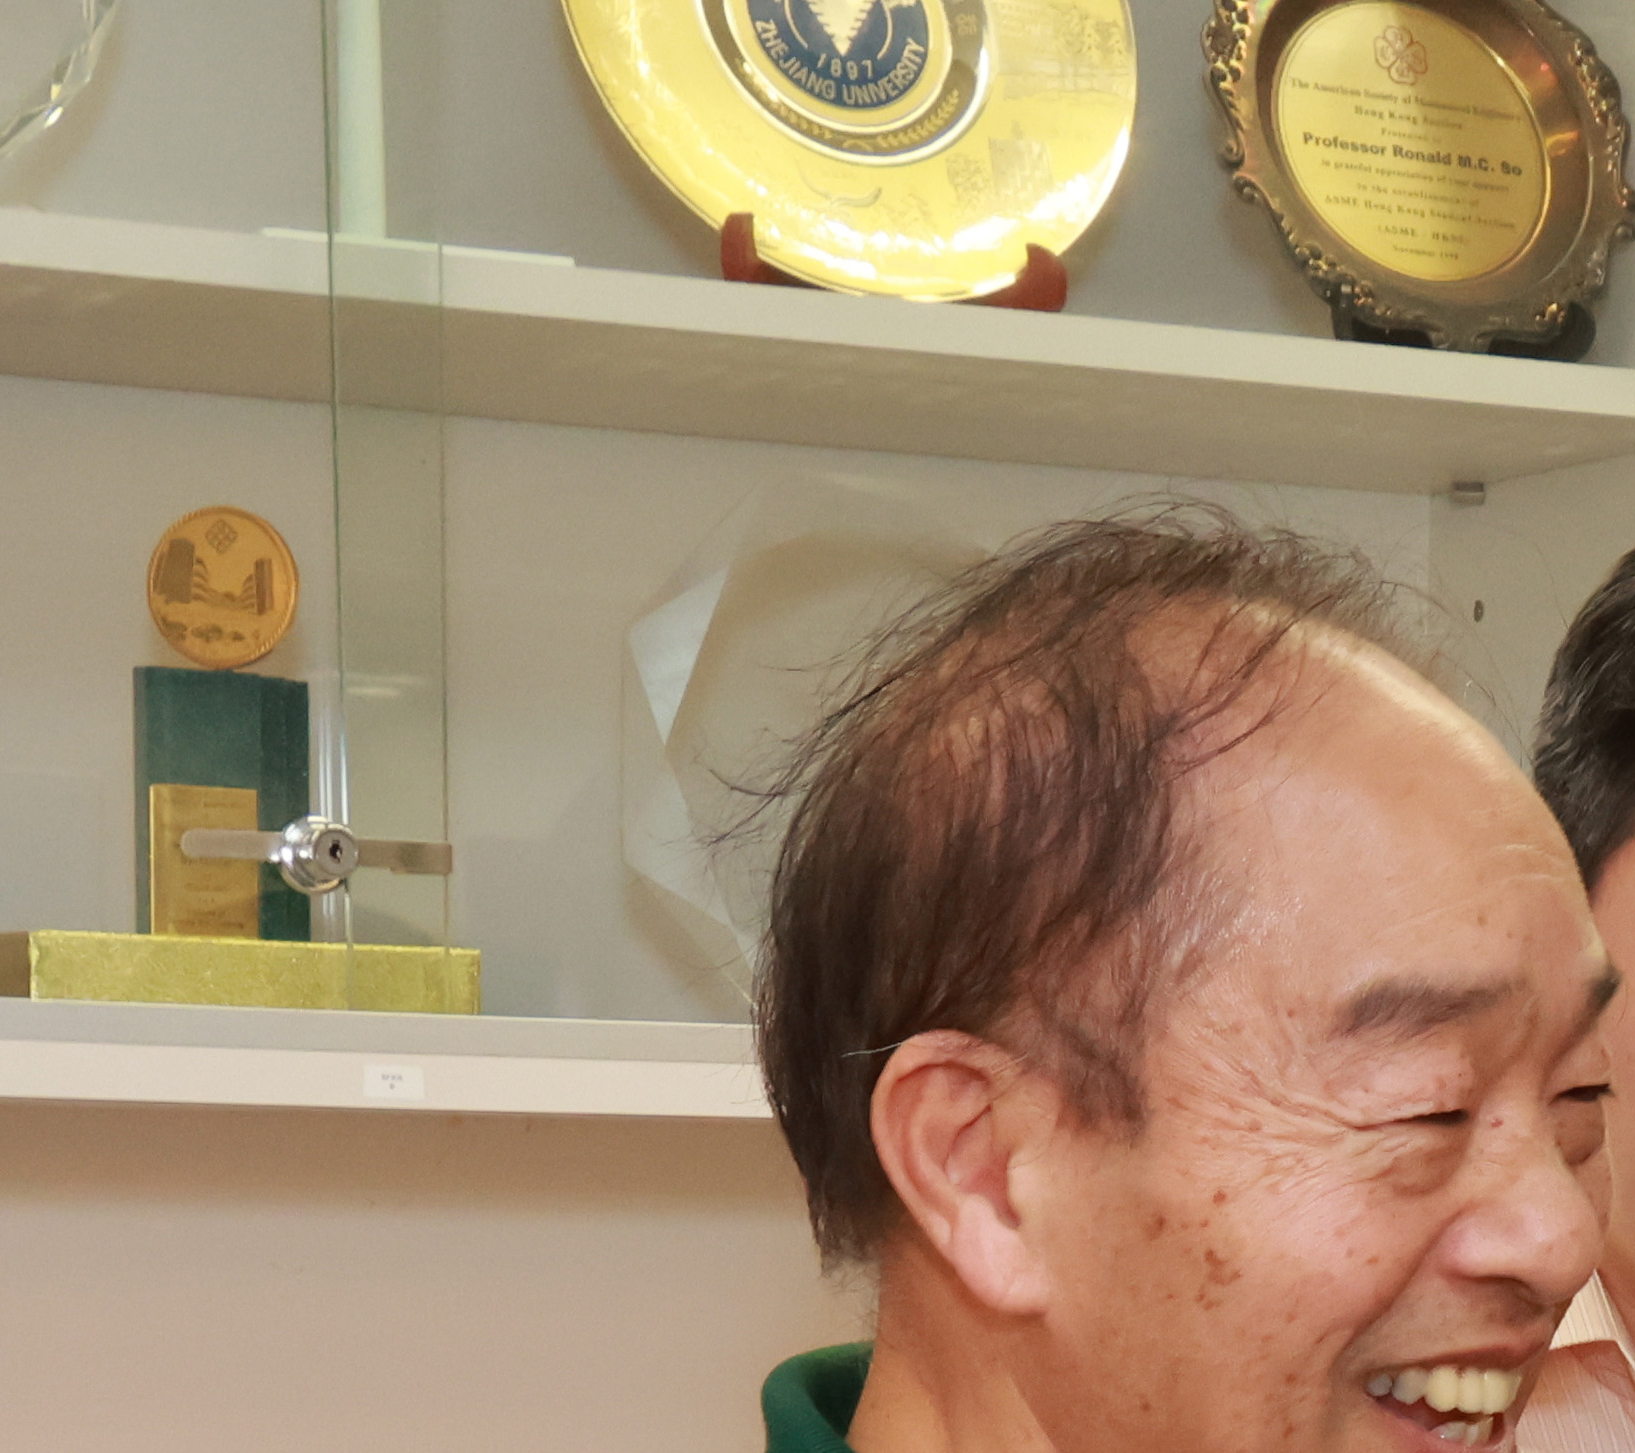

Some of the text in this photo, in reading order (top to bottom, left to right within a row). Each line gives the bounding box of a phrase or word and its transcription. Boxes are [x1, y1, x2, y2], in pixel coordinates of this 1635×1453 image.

[755, 19, 925, 106] ZHEJIANG UNIVERSITY
[817, 53, 873, 81] 1897
[1302, 131, 1523, 176] Professor Ronald M.C. So
